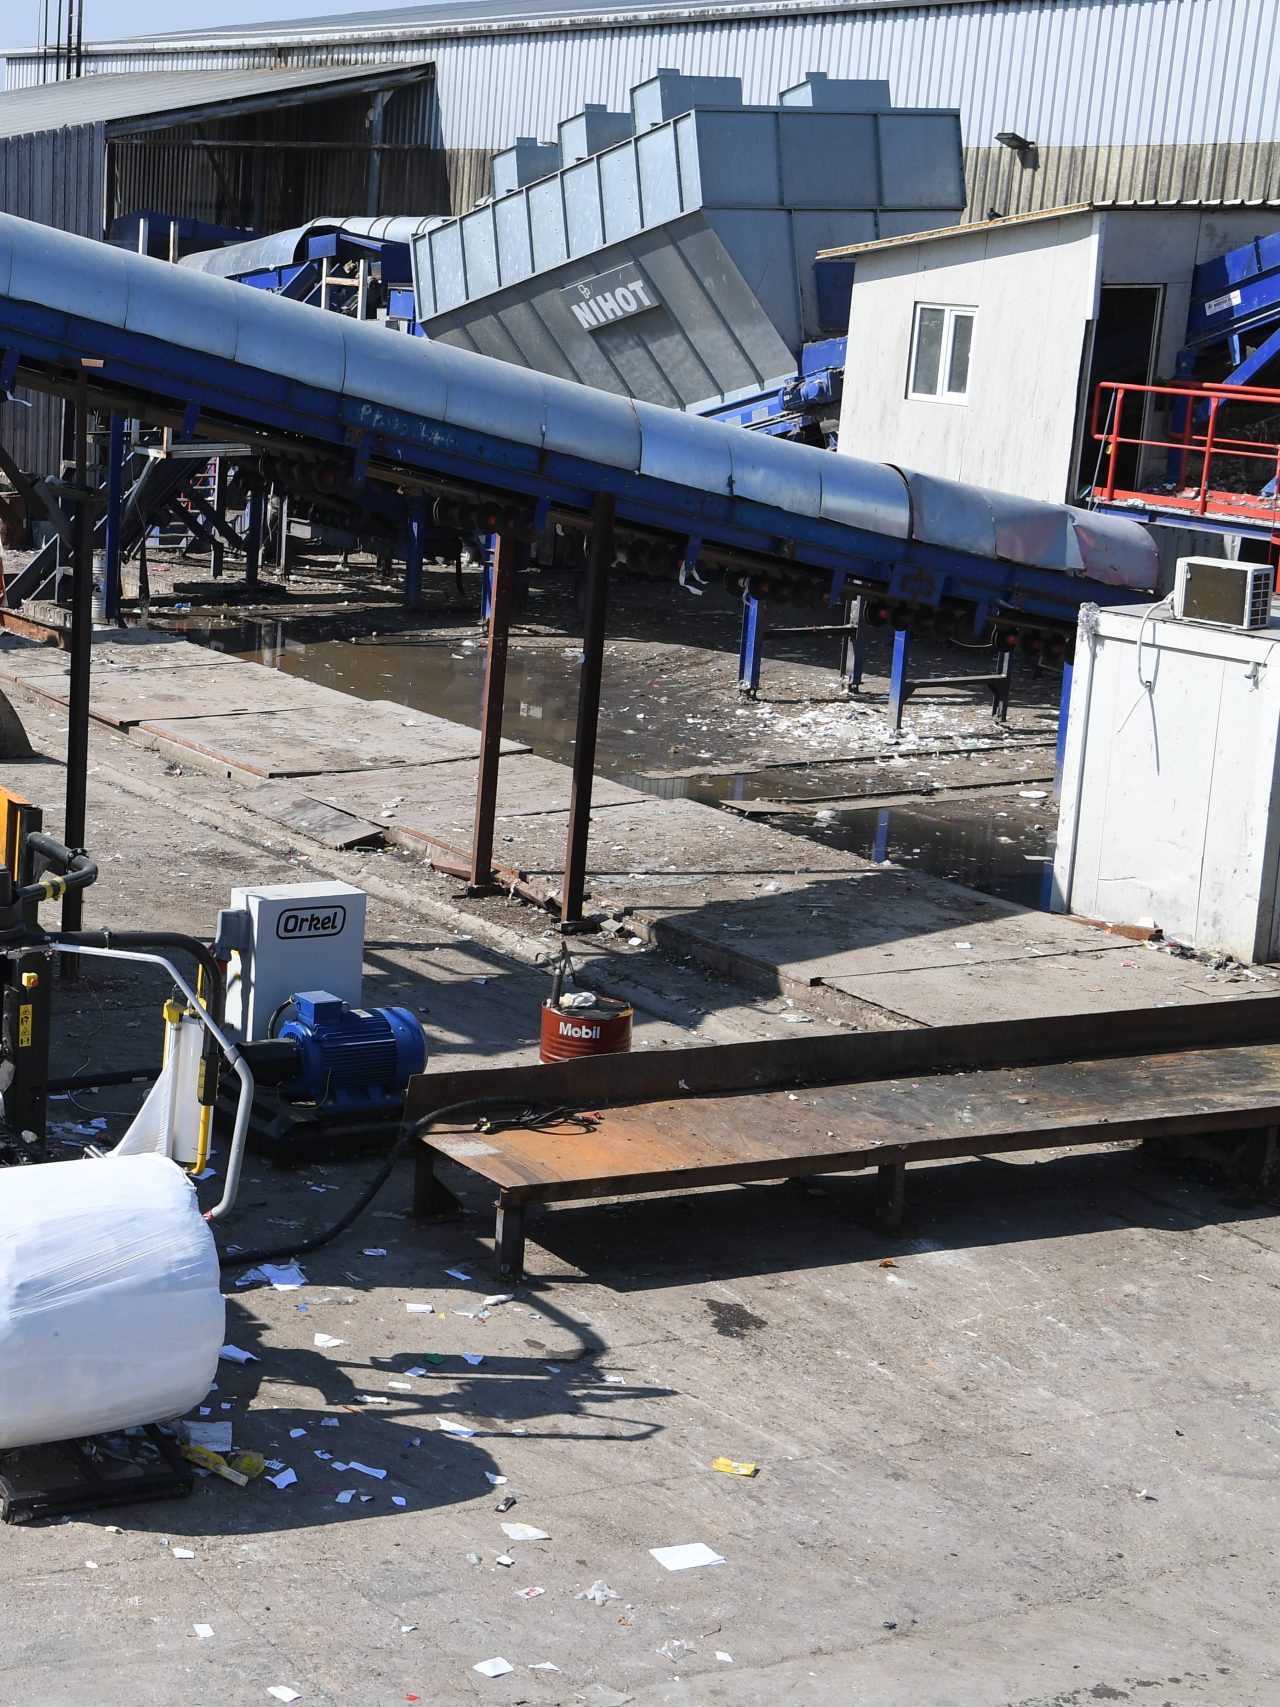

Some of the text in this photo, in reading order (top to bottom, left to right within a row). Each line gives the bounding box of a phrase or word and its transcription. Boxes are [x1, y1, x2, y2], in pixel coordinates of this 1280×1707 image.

[570, 279, 652, 329] NIHOT
[283, 912, 338, 934] Orkel
[558, 1021, 601, 1039] Mobil
